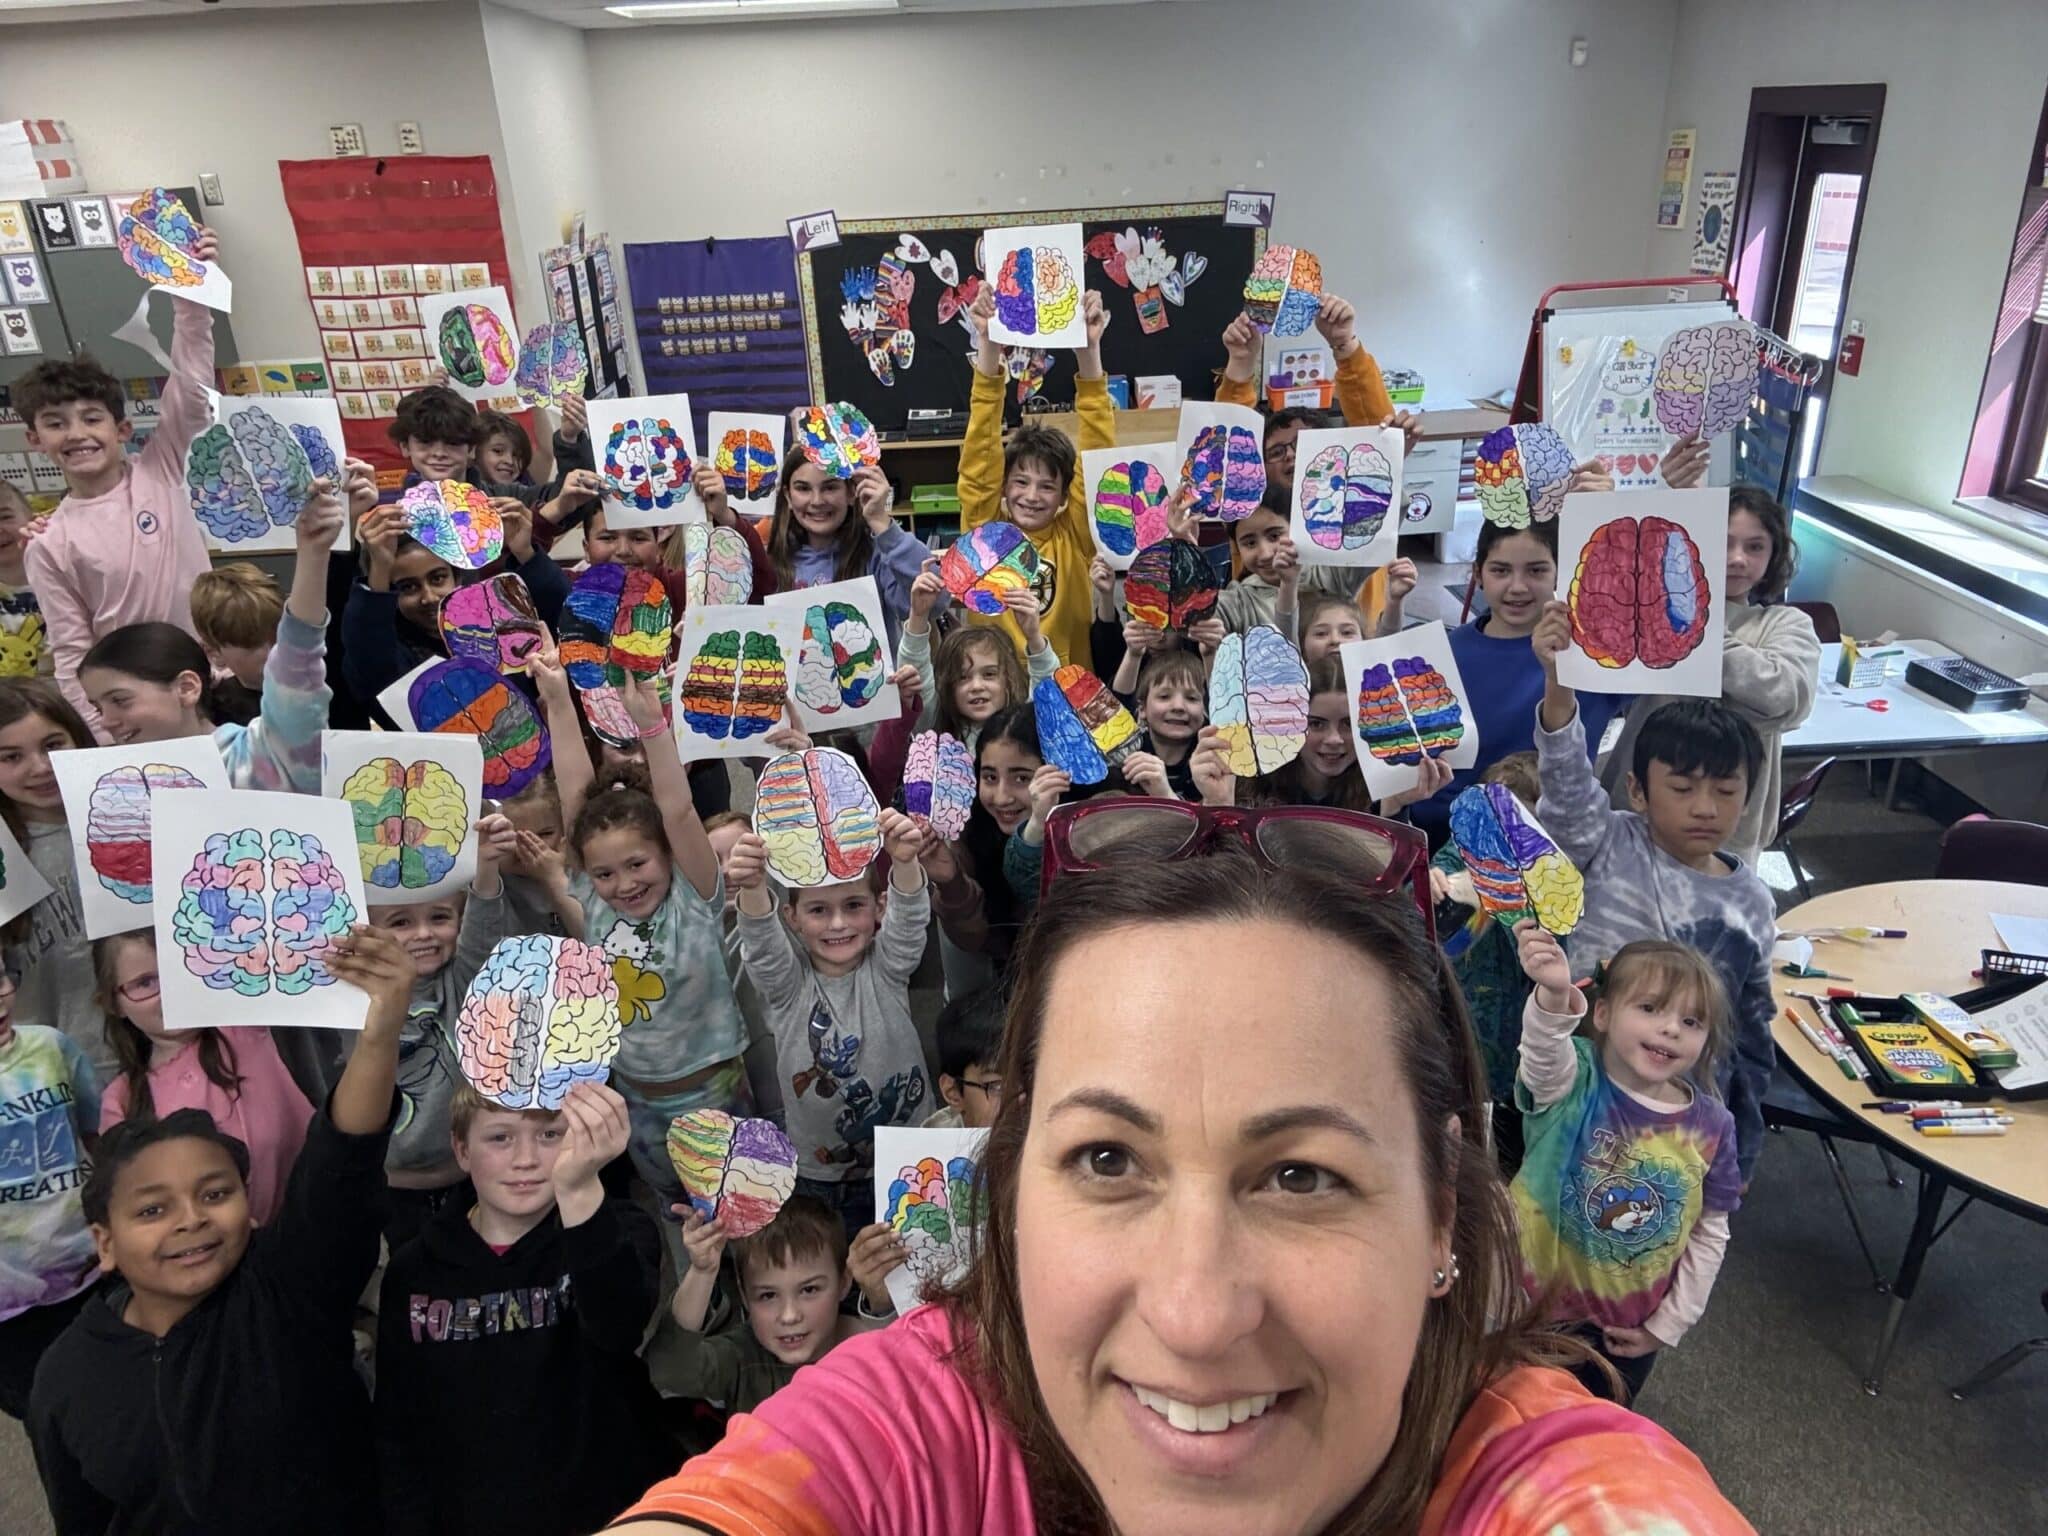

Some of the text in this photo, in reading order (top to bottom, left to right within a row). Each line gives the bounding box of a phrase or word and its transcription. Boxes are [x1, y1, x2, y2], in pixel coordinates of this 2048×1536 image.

[1229, 199, 1260, 215] Right
[804, 220, 831, 236] Left
[1872, 1031, 1922, 1041] Crayola
[409, 1278, 570, 1344] FORTNI
